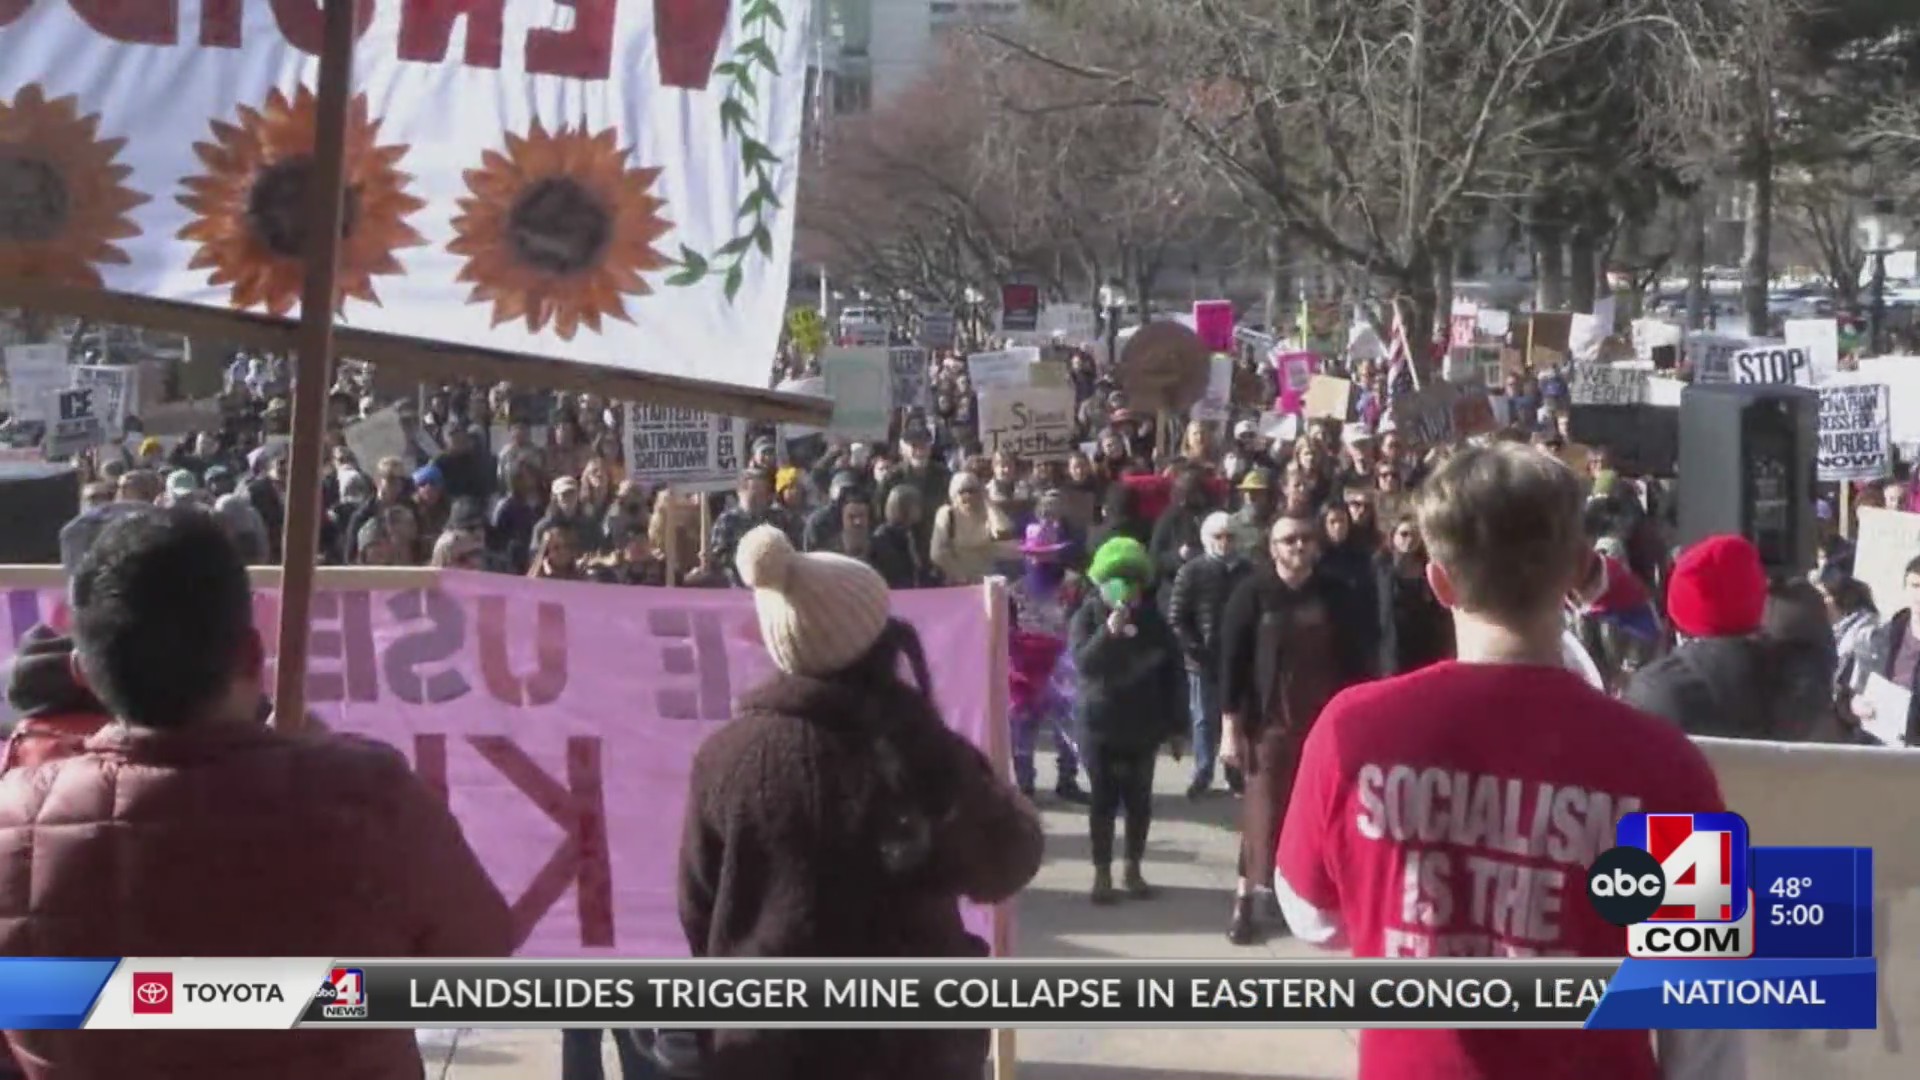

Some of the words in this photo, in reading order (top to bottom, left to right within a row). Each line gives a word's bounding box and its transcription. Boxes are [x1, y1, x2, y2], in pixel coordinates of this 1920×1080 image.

[1738, 348, 1804, 383] STOP
[1403, 850, 1452, 926] IS
[1466, 855, 1564, 940] THE
